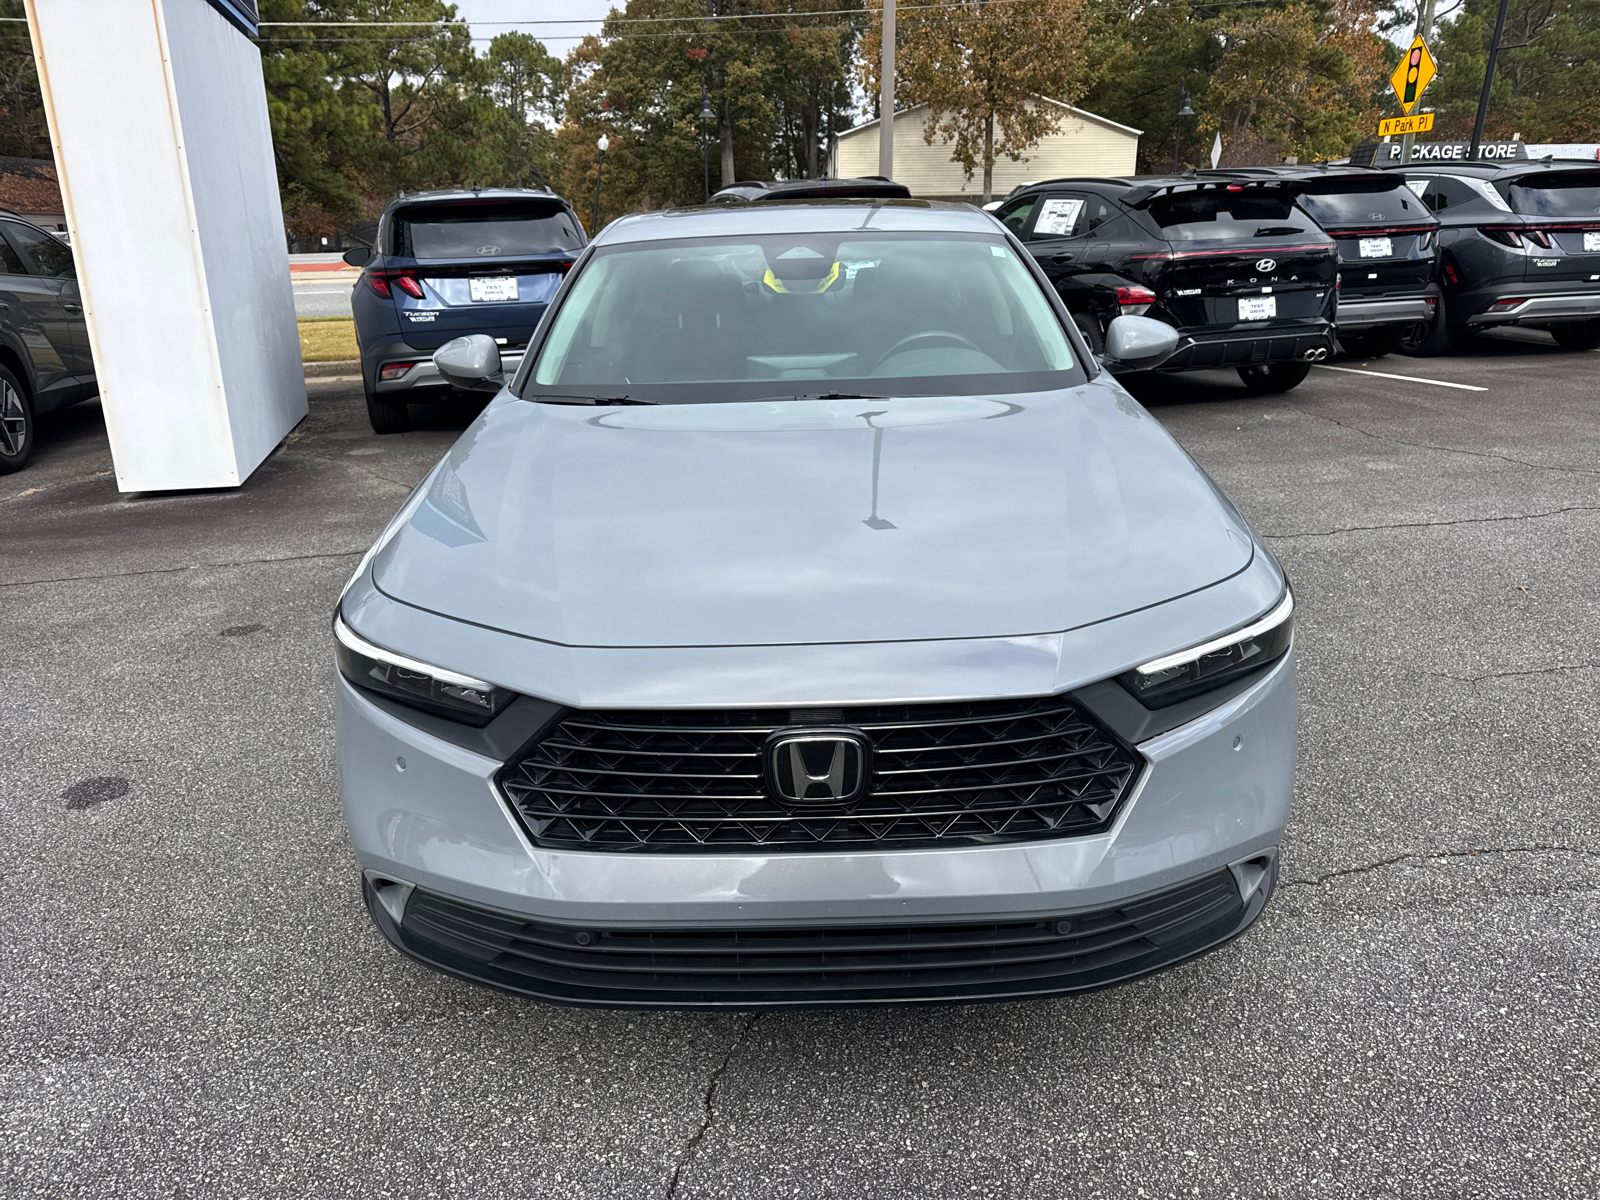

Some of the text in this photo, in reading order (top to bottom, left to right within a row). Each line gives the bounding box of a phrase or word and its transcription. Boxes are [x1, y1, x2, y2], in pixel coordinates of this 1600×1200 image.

[1384, 121, 1390, 133] N
[1394, 119, 1413, 132] Park
[1390, 145, 1463, 158] PCKAGE
[1227, 275, 1298, 285] KONA
